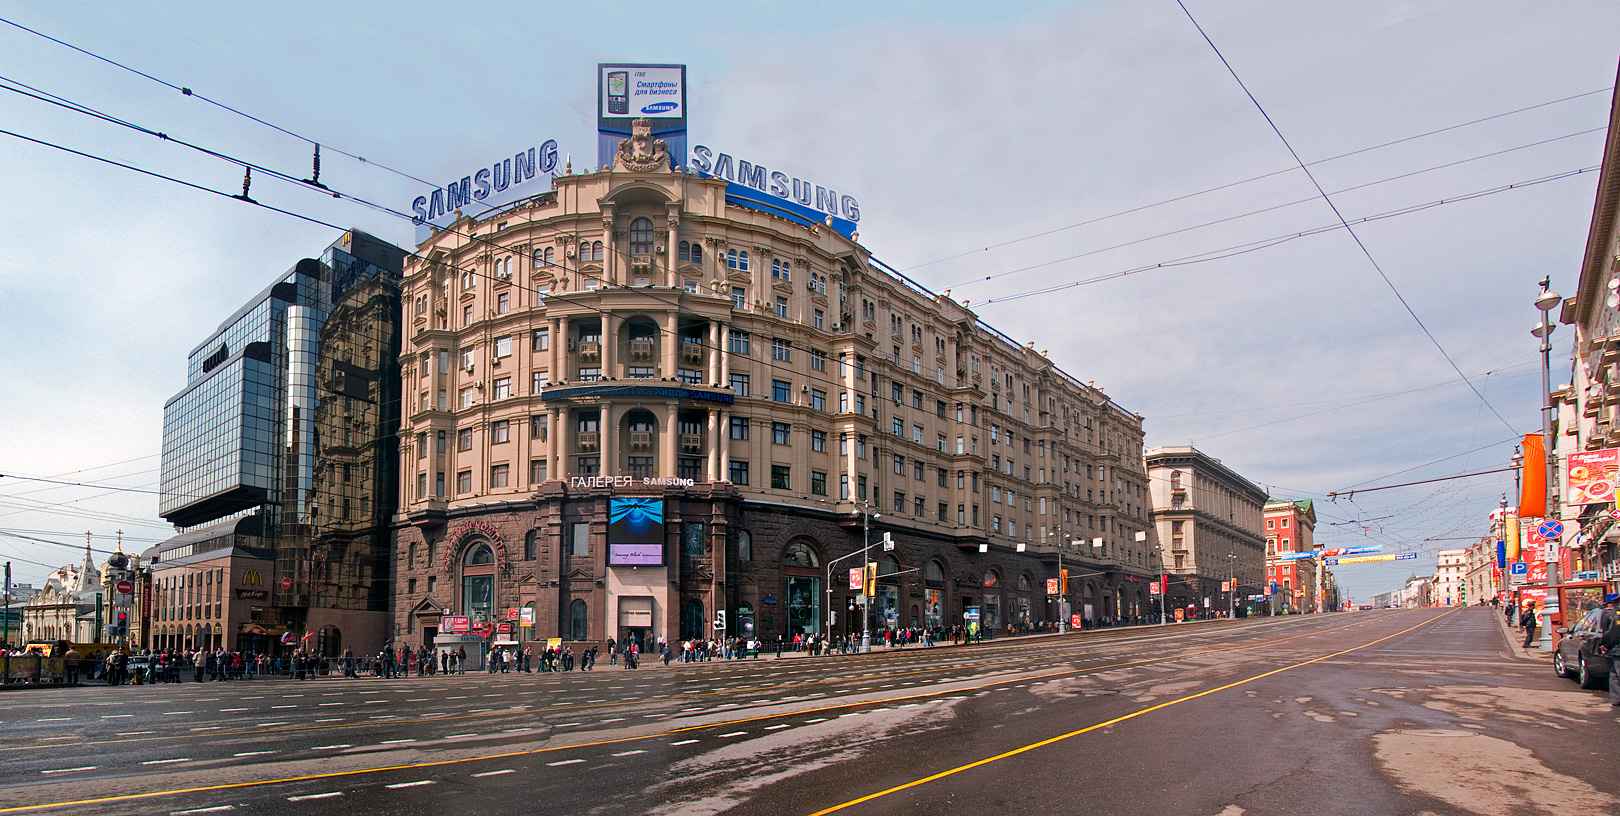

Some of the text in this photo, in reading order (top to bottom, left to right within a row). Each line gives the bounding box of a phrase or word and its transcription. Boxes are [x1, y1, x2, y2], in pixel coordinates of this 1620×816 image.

[412, 139, 558, 226] SAMSUNG
[692, 145, 860, 222] SAMSUNG
[571, 476, 632, 487] ГАЛЕРЕЯ
[643, 477, 694, 486] SAMSUNG
